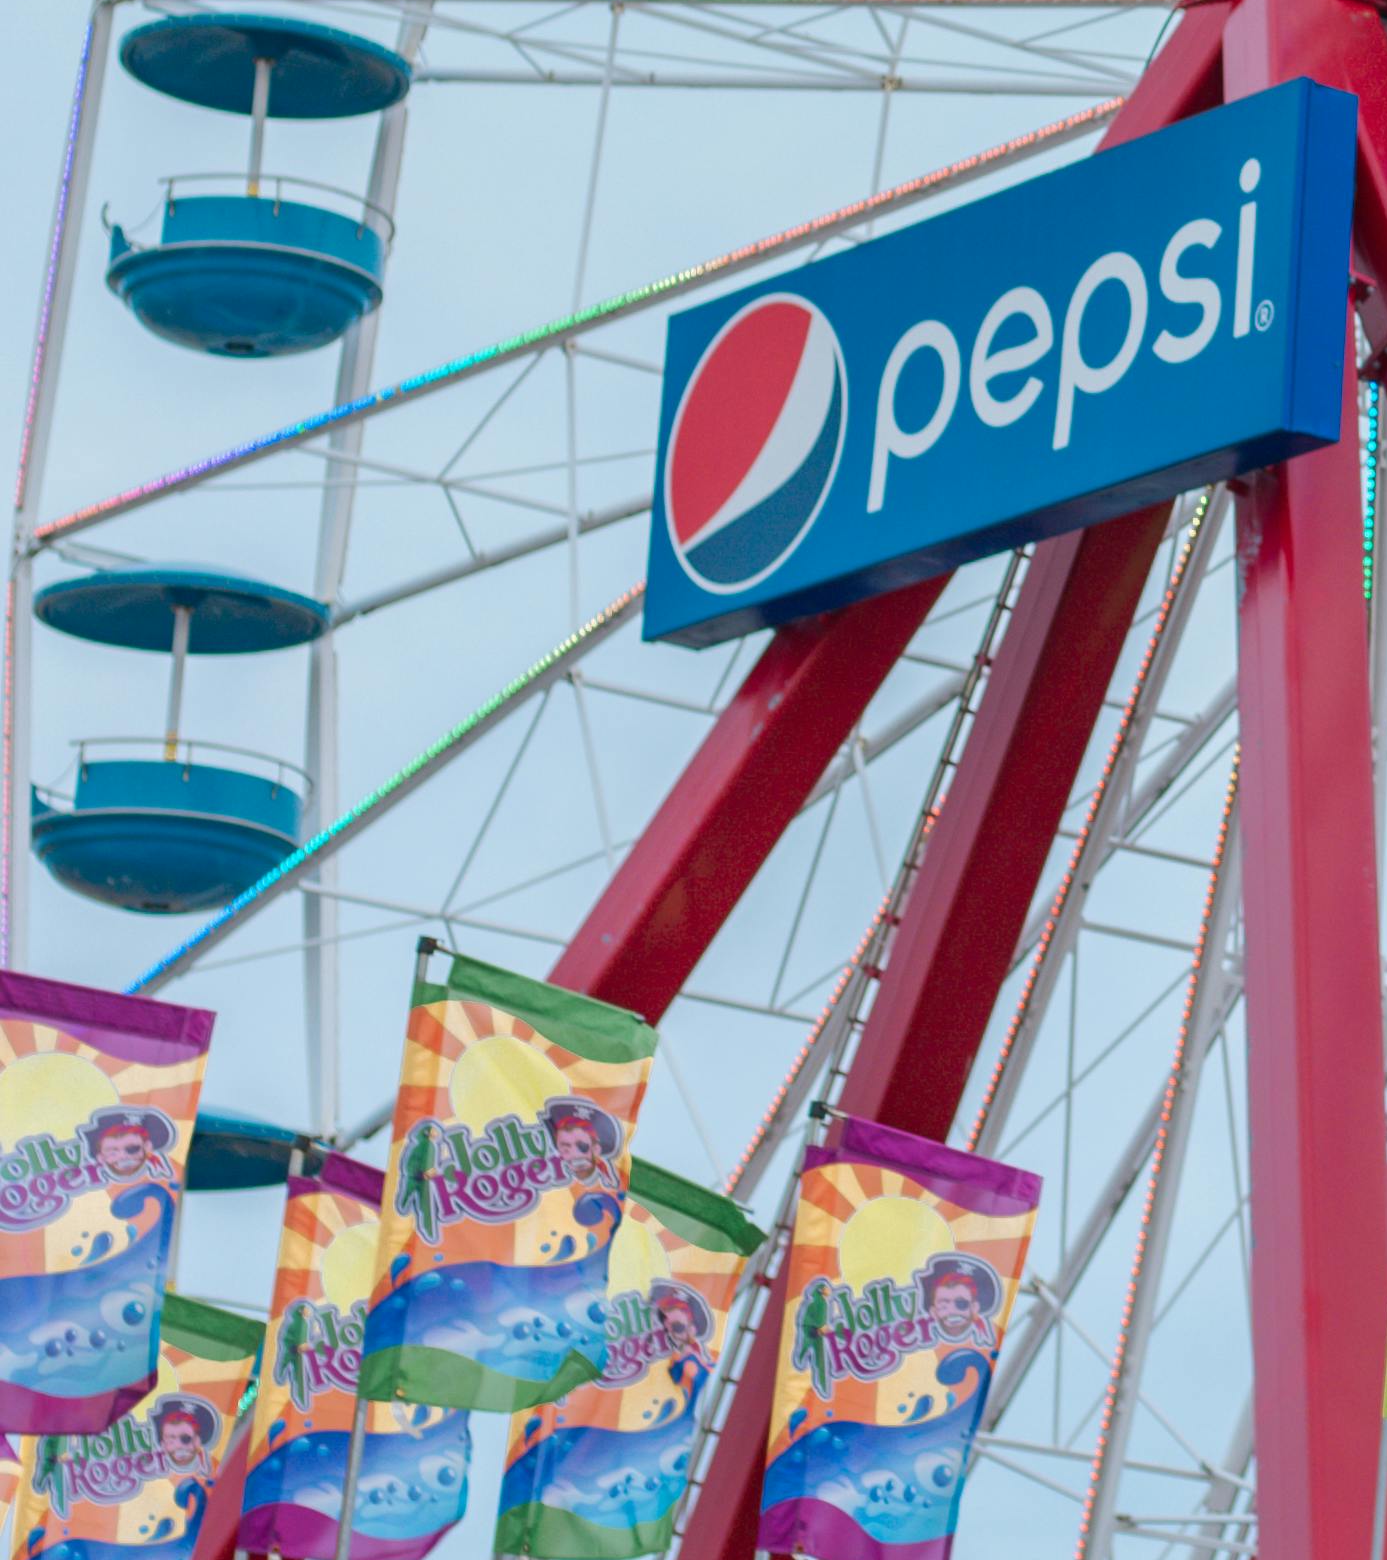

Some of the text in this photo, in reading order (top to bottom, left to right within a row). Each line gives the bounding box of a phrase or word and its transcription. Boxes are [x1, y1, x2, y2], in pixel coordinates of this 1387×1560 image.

[866, 157, 1262, 515] pepsi
[0, 1139, 82, 1183] olly
[442, 1121, 548, 1178] Jolly
[0, 1163, 105, 1226] oger
[432, 1156, 568, 1217] Roger
[835, 1284, 917, 1338] Jolly
[825, 1315, 934, 1375] Roger
[73, 1418, 154, 1463] Jolly
[65, 1450, 169, 1496] Roger
